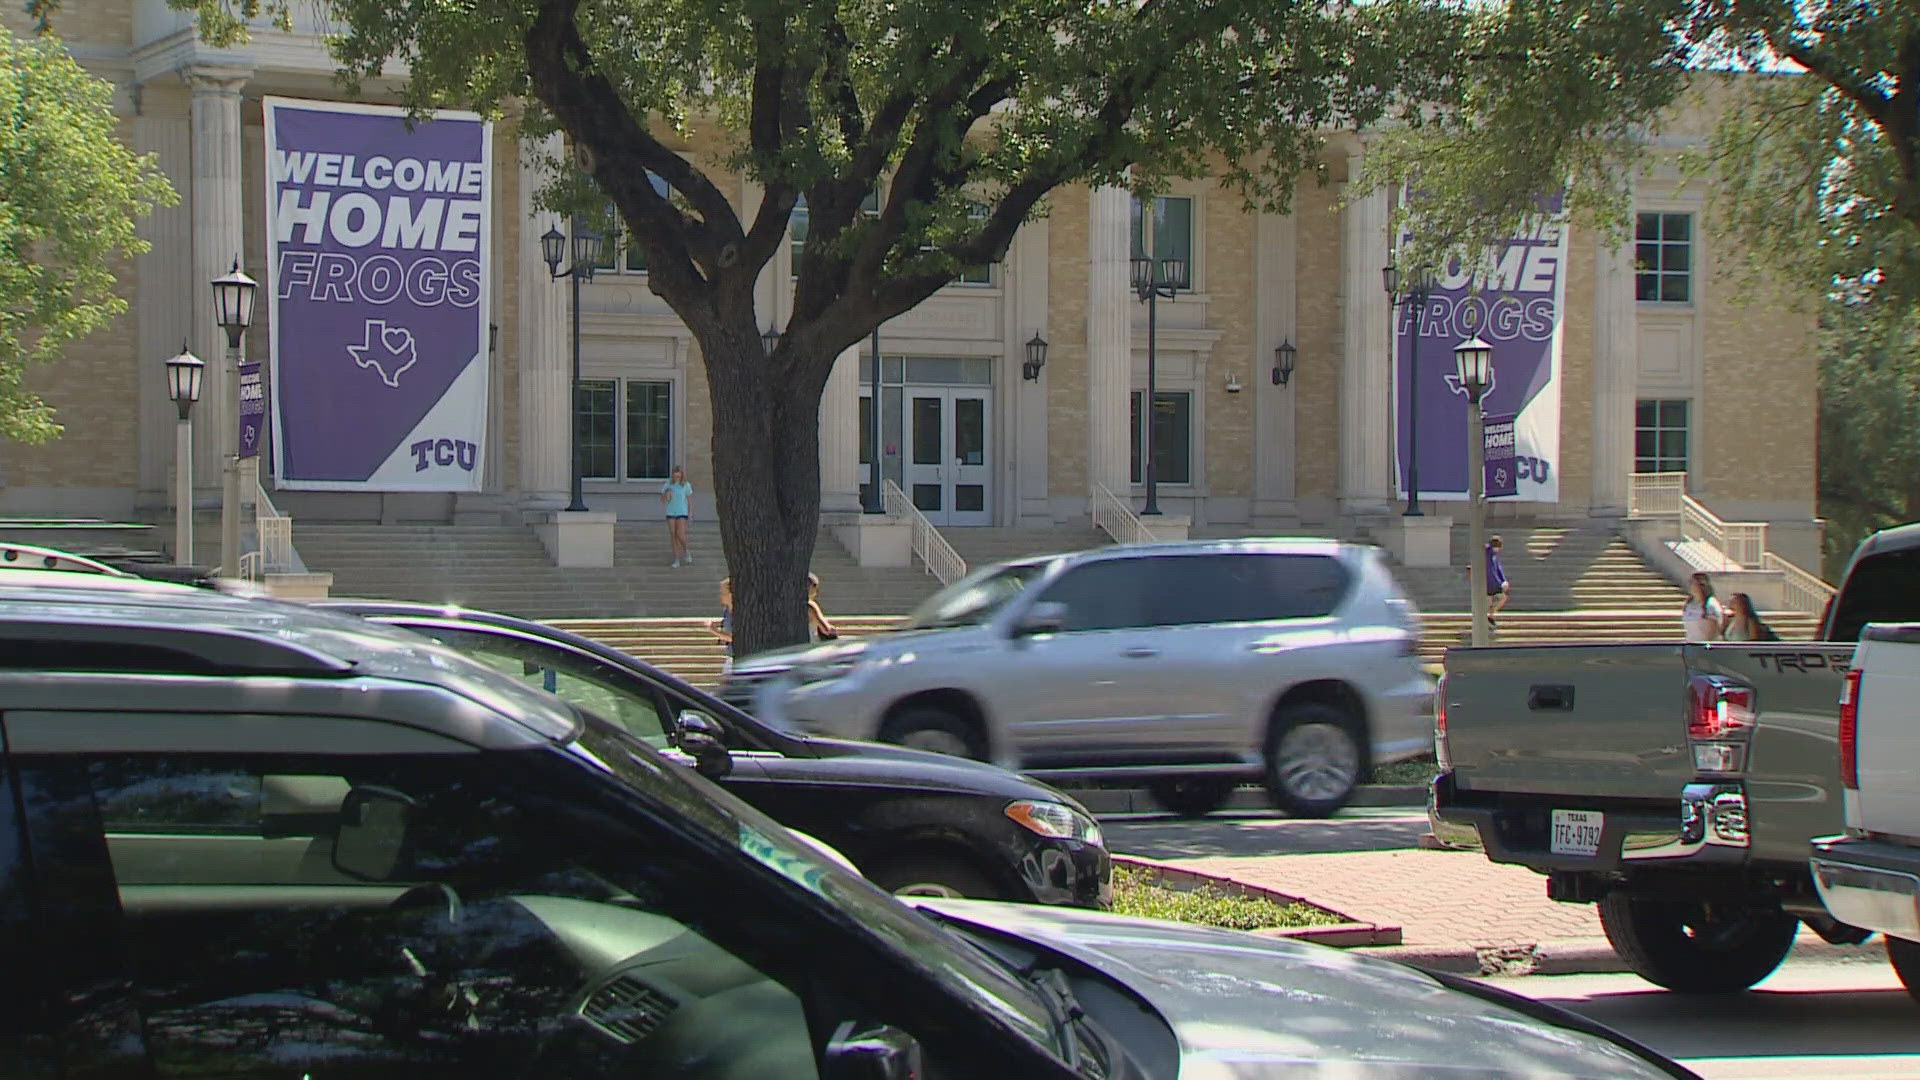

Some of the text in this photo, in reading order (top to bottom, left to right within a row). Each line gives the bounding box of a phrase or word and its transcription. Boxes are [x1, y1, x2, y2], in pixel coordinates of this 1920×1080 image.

[276, 149, 482, 195] WELCOME
[277, 189, 481, 253] HOME
[278, 251, 481, 308] FROGS
[1410, 241, 1557, 292] OME
[410, 438, 477, 473] TCU
[1484, 432, 1515, 449] HOME
[1515, 455, 1550, 484] CU
[1749, 653, 1828, 673] TRD
[1567, 813, 1587, 822] TEXAS
